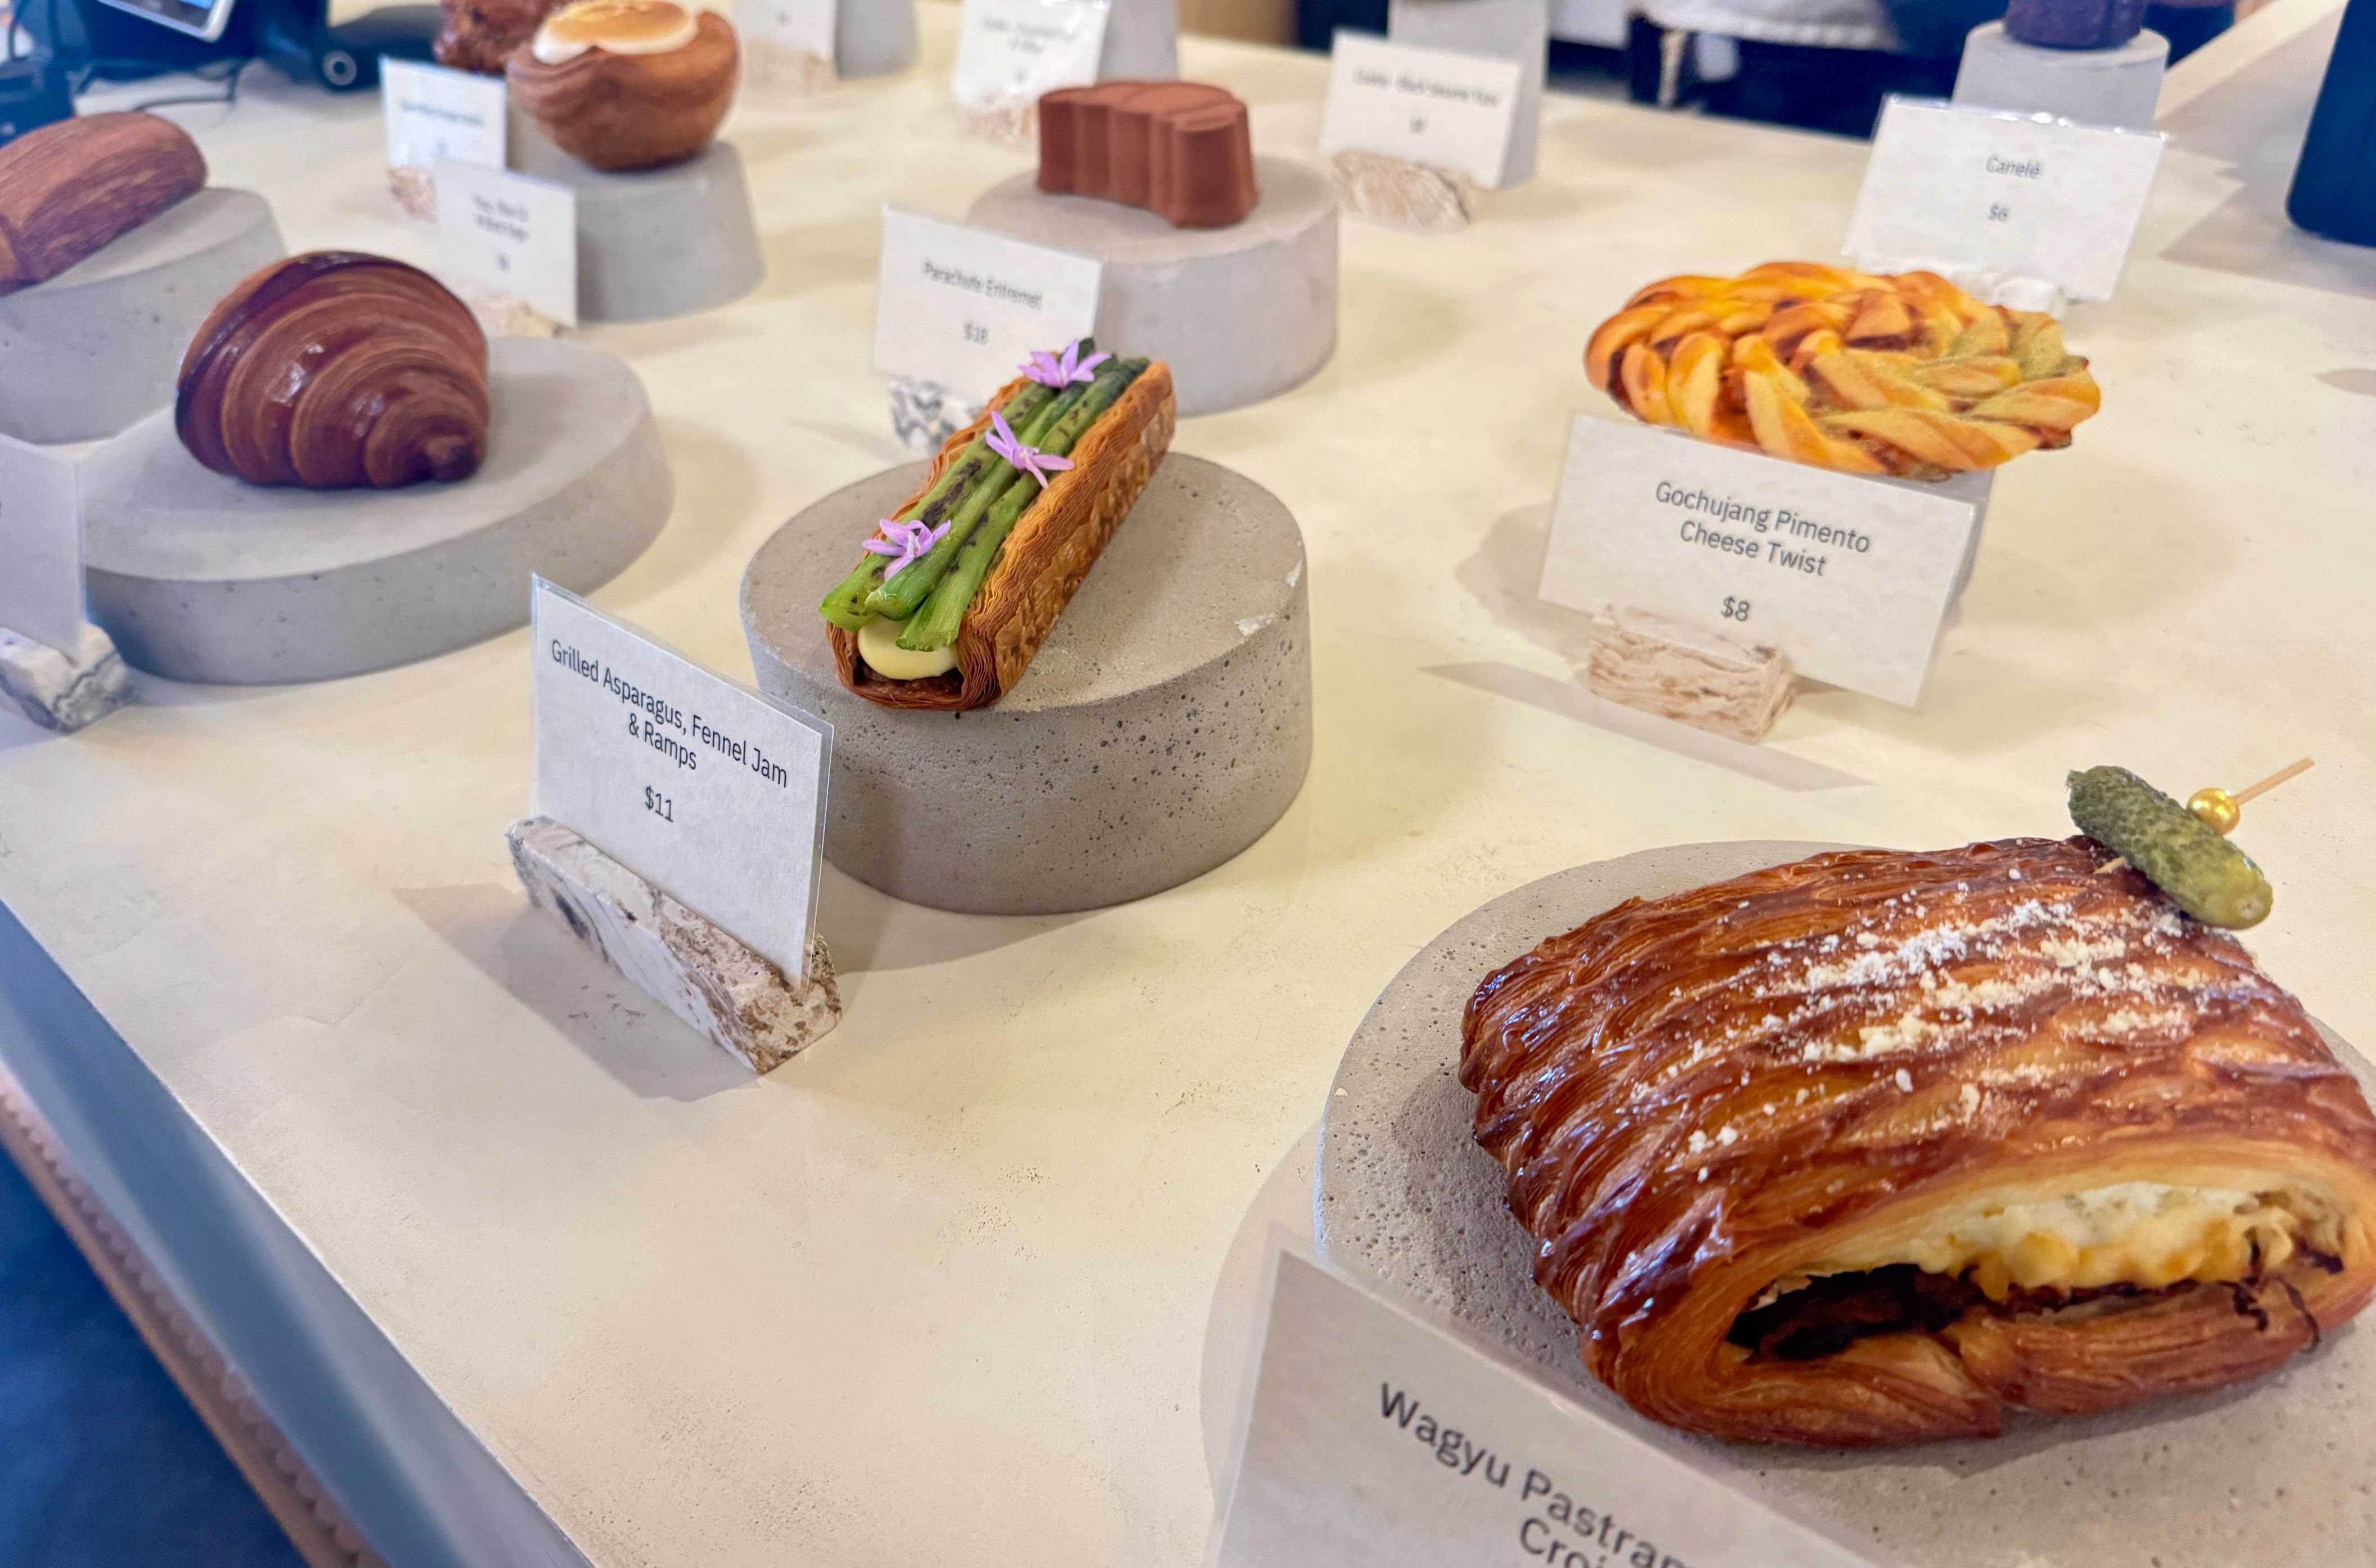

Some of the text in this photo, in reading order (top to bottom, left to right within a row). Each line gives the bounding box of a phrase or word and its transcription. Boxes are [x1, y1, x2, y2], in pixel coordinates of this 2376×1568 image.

[1655, 480, 1870, 553] Gochujang Pimento
[1680, 520, 1827, 577] Cheese Twist
[1721, 595, 1750, 622] $8
[552, 639, 787, 788] Grilled Asparagus, Fennel Jam
[629, 713, 696, 771] & Ramps
[645, 785, 674, 823] $11
[1380, 1381, 1511, 1489] Wagyu
